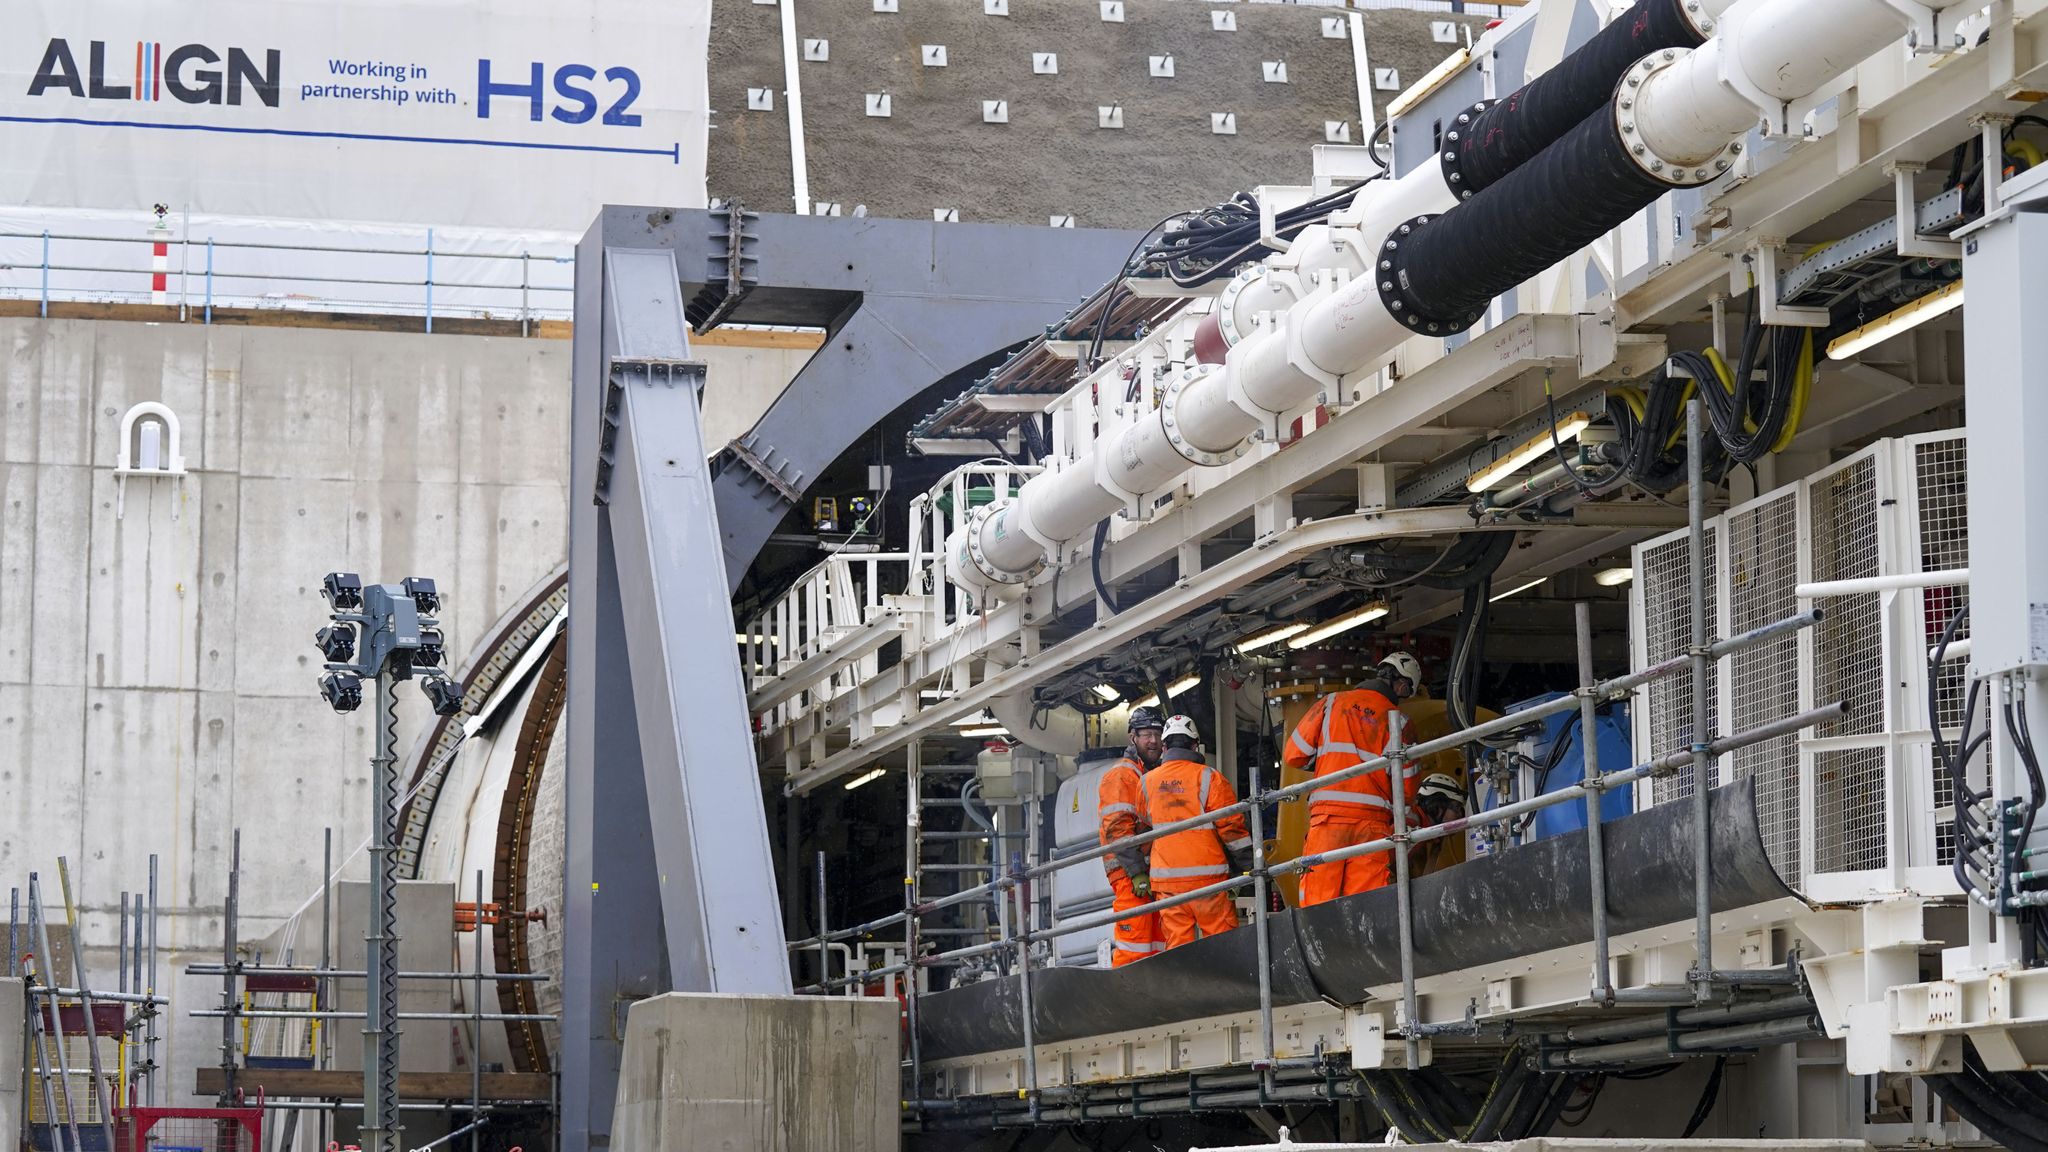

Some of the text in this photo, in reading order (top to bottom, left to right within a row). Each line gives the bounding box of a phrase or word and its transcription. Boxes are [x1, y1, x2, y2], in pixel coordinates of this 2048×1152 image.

[27, 38, 281, 108] ALIGN
[328, 59, 427, 82] Working in
[301, 83, 457, 106] partnership with
[477, 58, 642, 127] HS2
[1352, 703, 1376, 716] ALGN
